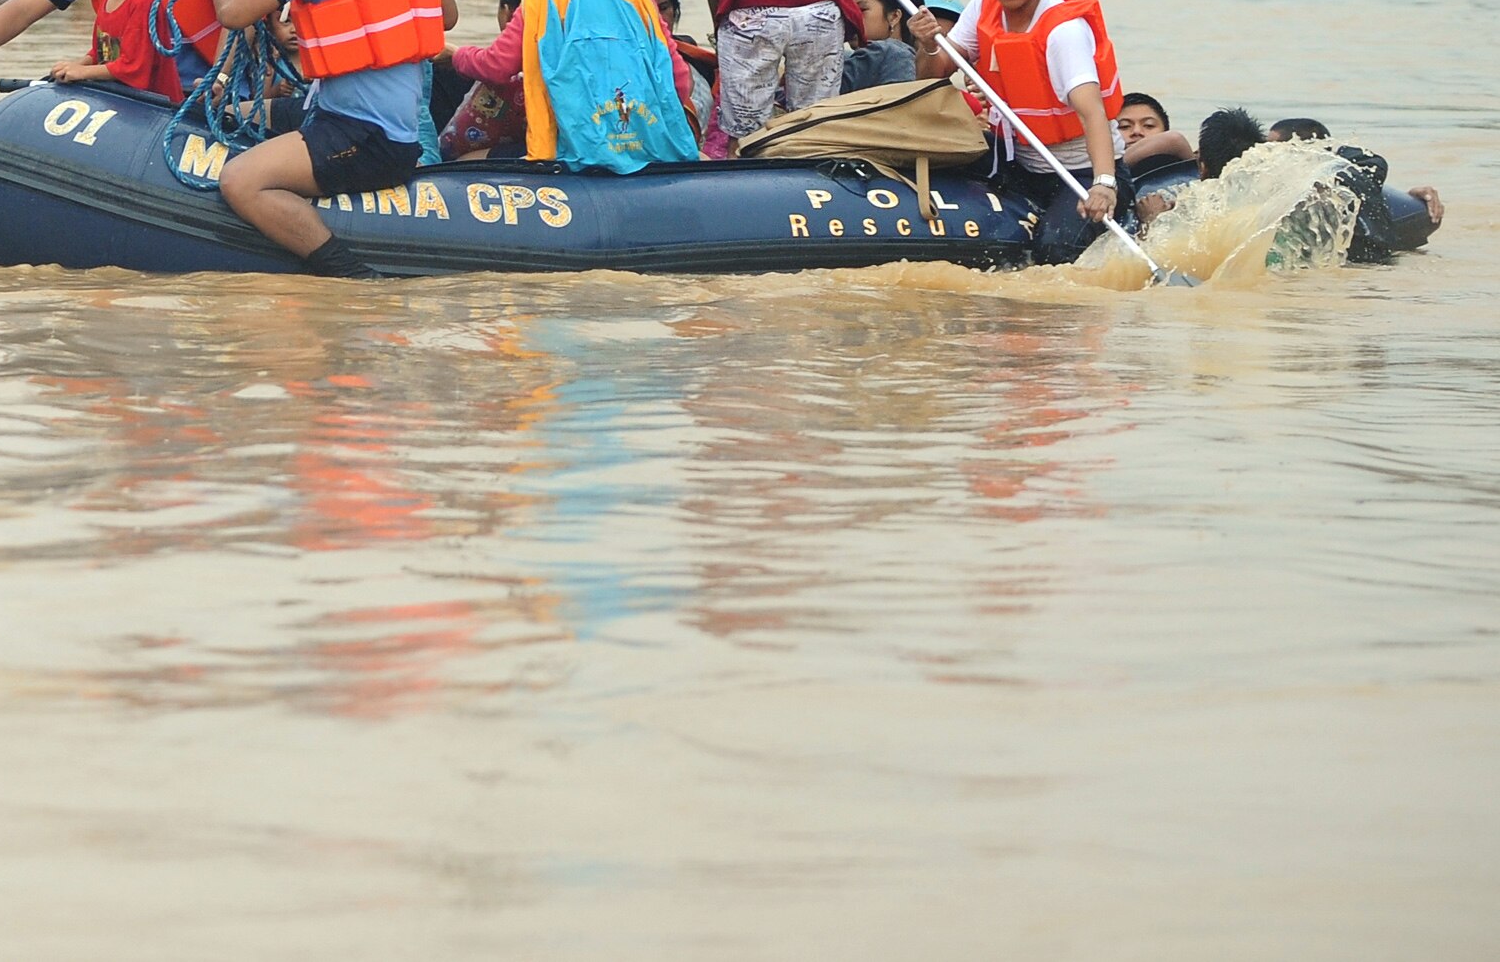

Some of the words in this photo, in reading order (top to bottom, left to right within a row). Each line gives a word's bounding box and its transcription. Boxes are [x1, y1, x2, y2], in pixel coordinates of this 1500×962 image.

[43, 99, 118, 147] 01
[466, 182, 573, 228] CPS
[788, 213, 981, 238] Rescue
